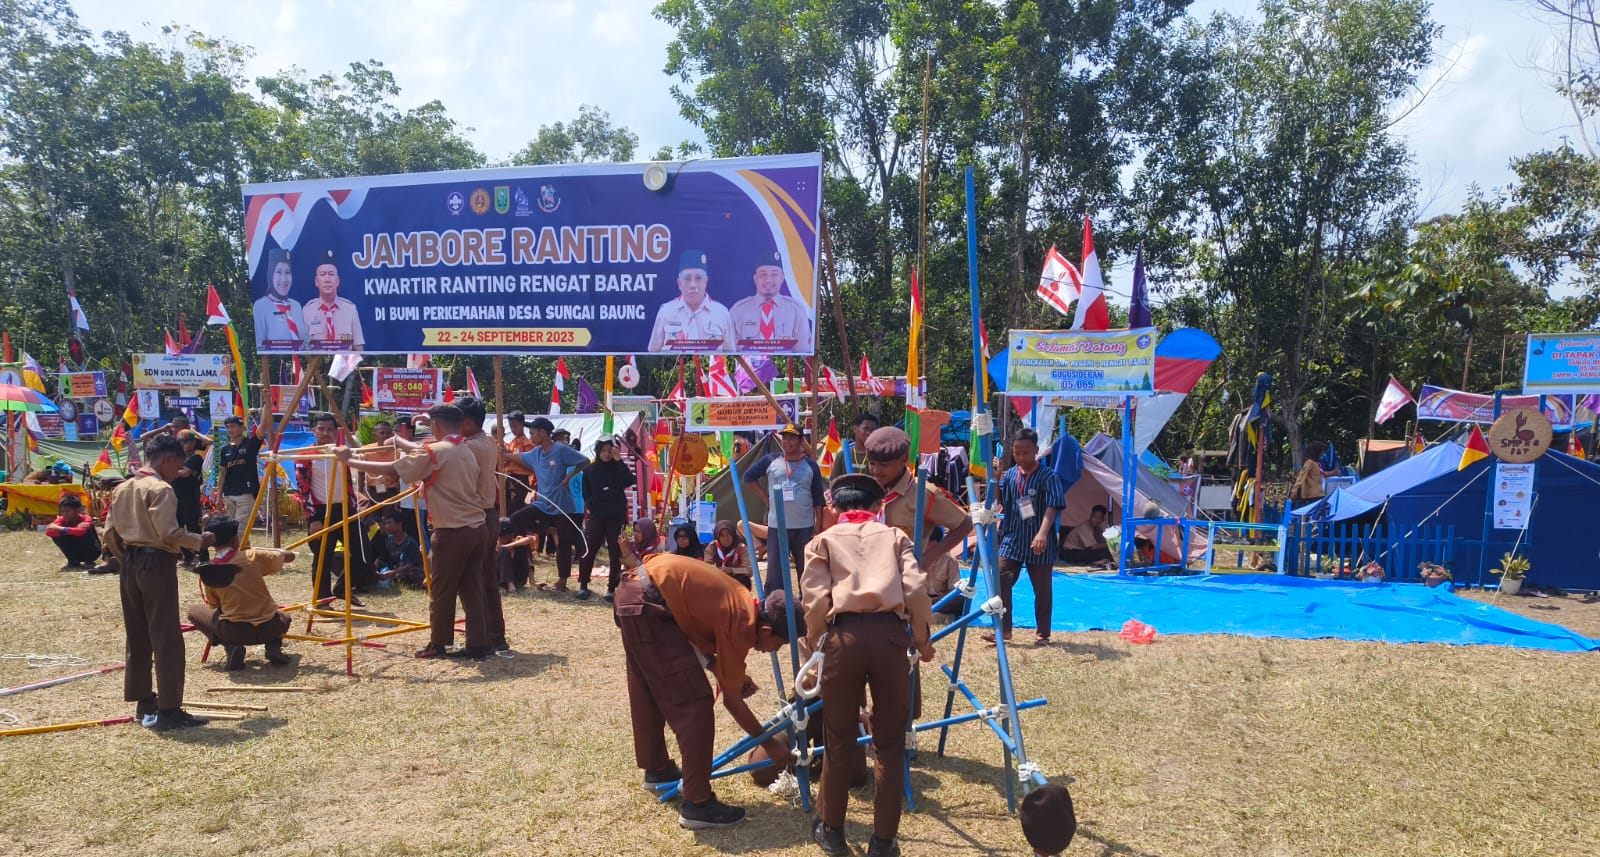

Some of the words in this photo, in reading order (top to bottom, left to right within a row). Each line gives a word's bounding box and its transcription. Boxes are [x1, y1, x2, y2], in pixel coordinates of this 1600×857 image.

[352, 227, 507, 269] JAMBORE
[511, 223, 672, 265] RANTING
[364, 277, 438, 296] KWARTIR
[440, 275, 517, 294] RANTING
[519, 274, 590, 293] RENGAT
[594, 273, 658, 292] BARAT
[375, 307, 386, 321] DI
[389, 306, 420, 321] BUMI
[423, 305, 505, 320] PERKEMAHAN
[508, 305, 542, 320] DESA
[545, 304, 595, 320] SUNGAI
[599, 304, 646, 320] BAUNG
[437, 331, 452, 342] 22
[460, 331, 475, 342] 24
[476, 331, 544, 342] SEPTEMBER
[545, 331, 575, 342] 2023
[1035, 340, 1081, 353] Selamat
[1083, 340, 1127, 356] Datang
[196, 369, 217, 377] LAMA
[1052, 370, 1077, 379] GUGUS
[1079, 370, 1104, 379] DEPAN
